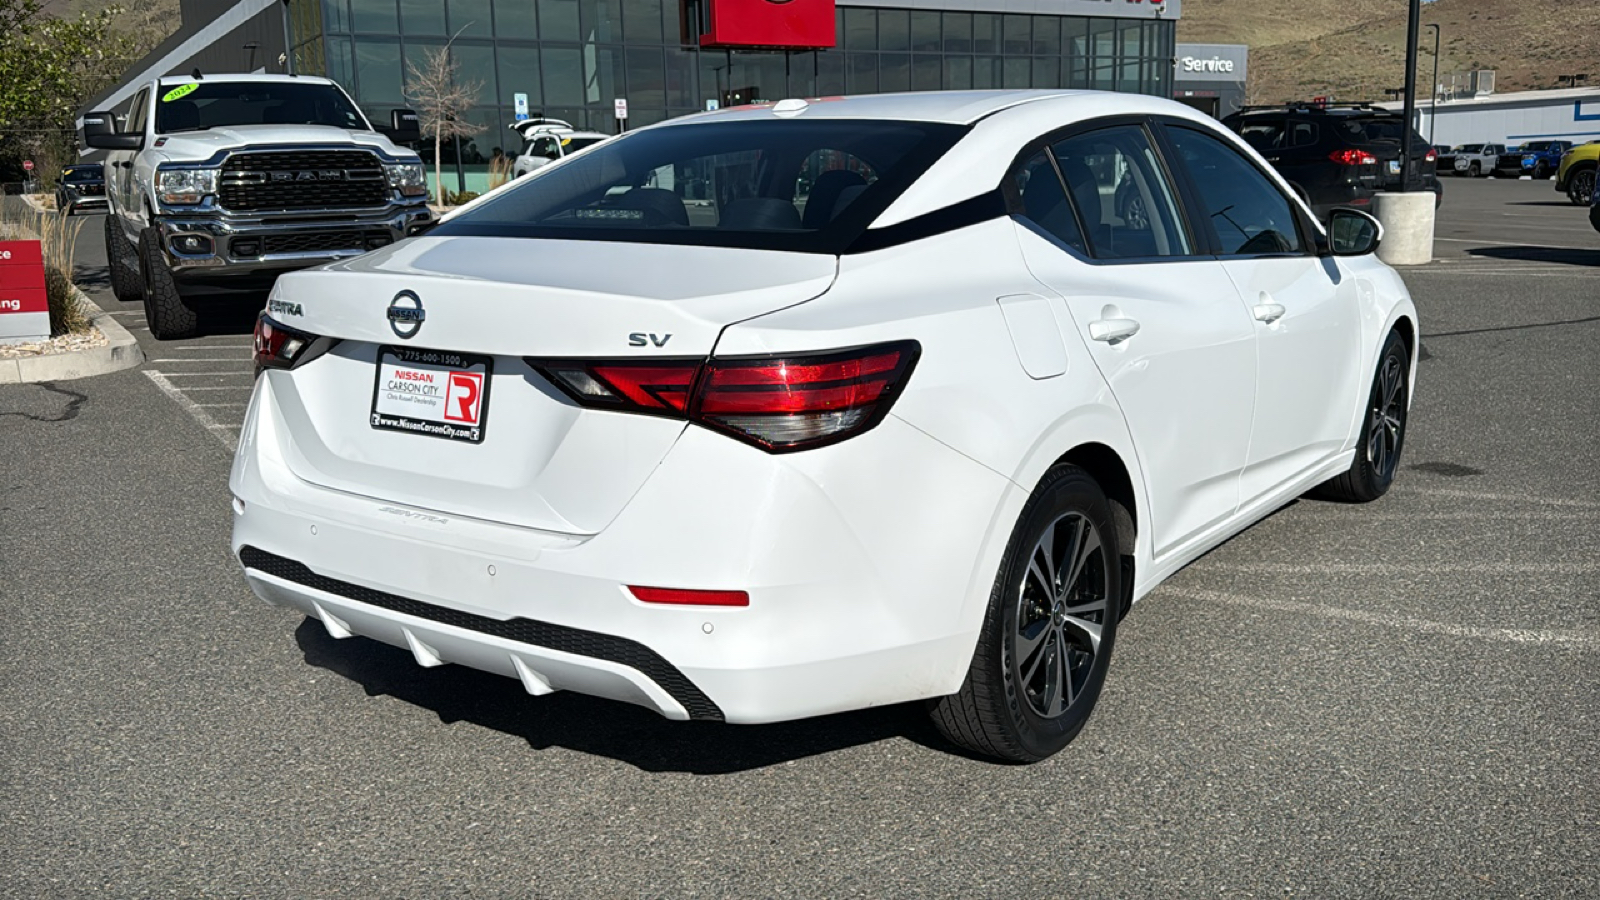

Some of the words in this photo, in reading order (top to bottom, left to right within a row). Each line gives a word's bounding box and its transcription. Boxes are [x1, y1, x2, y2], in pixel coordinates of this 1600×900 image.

[1183, 56, 1234, 72] Service
[270, 169, 341, 181] RAM
[390, 309, 420, 319] NISSAN
[628, 332, 673, 347] SV
[404, 350, 461, 365] 775-600-1500
[394, 370, 434, 383] NISSAN
[387, 380, 421, 393] CARSON
[422, 384, 439, 396] CITY
[452, 375, 477, 421] R
[380, 418, 471, 438] www.NissanCarsonCity.com
